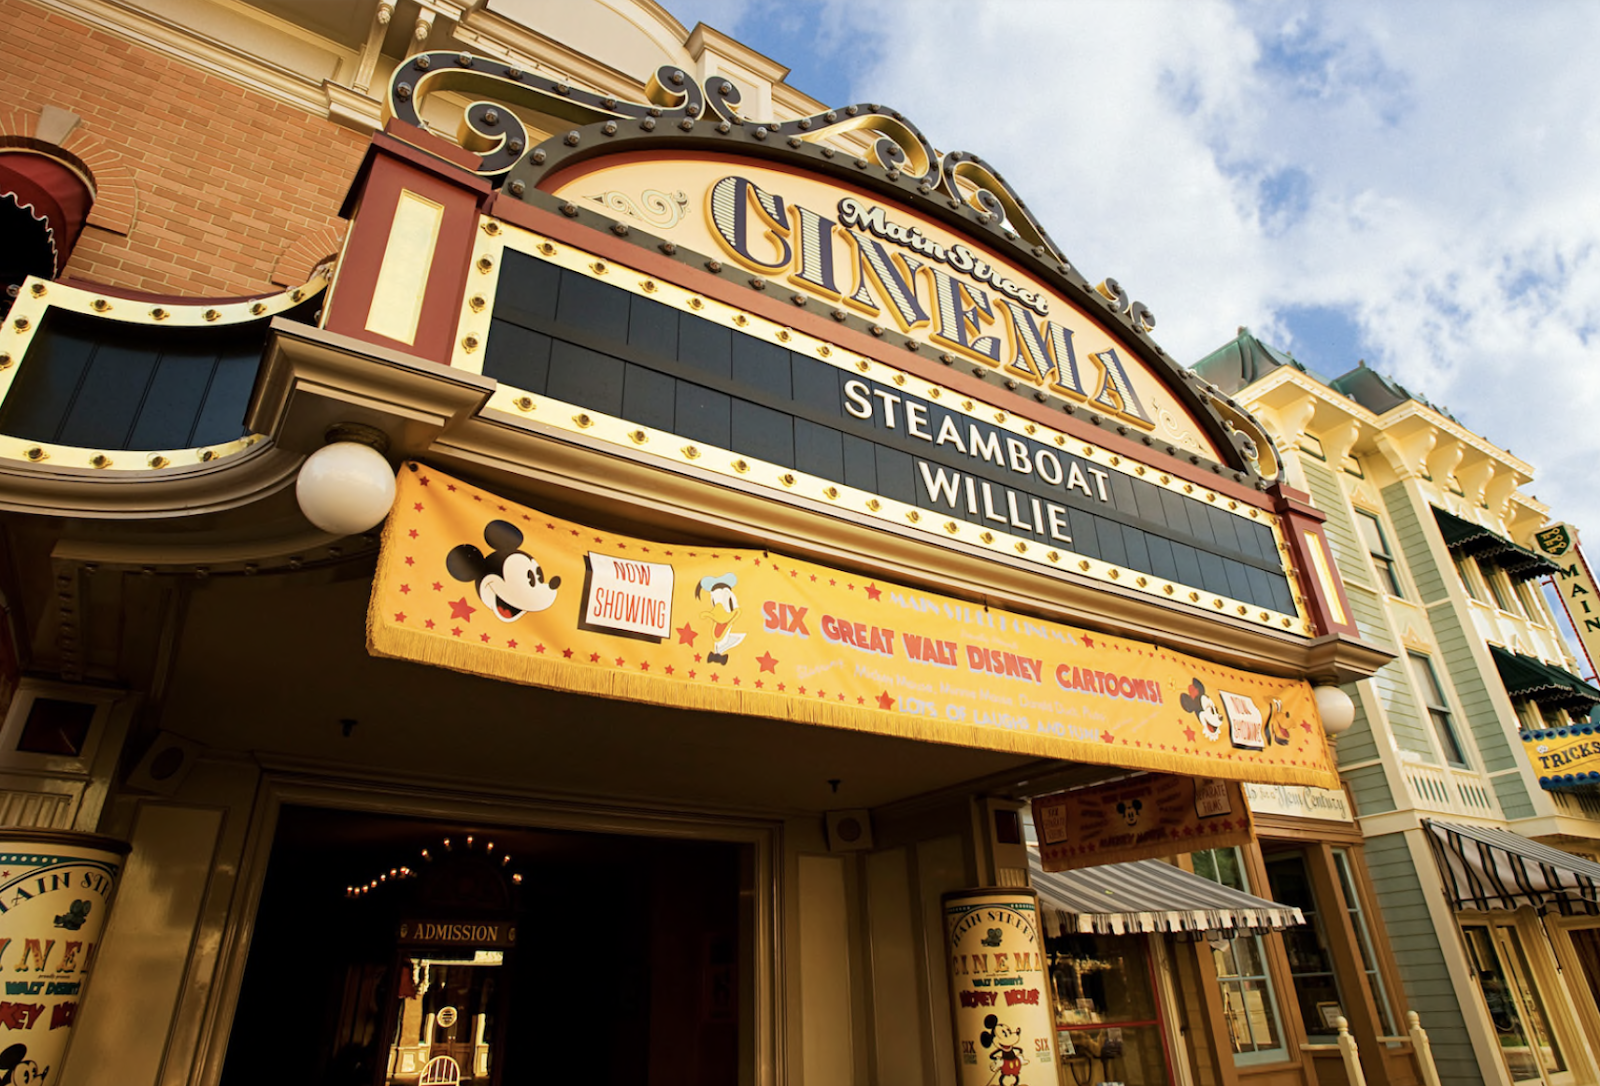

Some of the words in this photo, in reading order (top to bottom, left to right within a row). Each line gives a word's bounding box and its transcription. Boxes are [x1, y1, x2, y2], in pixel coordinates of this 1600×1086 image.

[838, 197, 947, 260] Main
[945, 241, 1051, 316] Street
[704, 176, 1157, 431] CINEMA
[843, 379, 1109, 502] STEAMBOAT
[917, 461, 1073, 543] WILLIE
[613, 560, 651, 587] NOW
[593, 587, 666, 629] SHOWING
[762, 601, 811, 637] SIX
[820, 614, 895, 657] GREAT
[902, 632, 958, 669] WALT
[965, 644, 1043, 684] DISNEY
[1055, 663, 1163, 705] CARTOONS!
[1538, 741, 1600, 769] TRICKS
[1303, 786, 1347, 819] Century
[413, 923, 499, 941] ADMISSION
[1034, 1037, 1050, 1052] SIX
